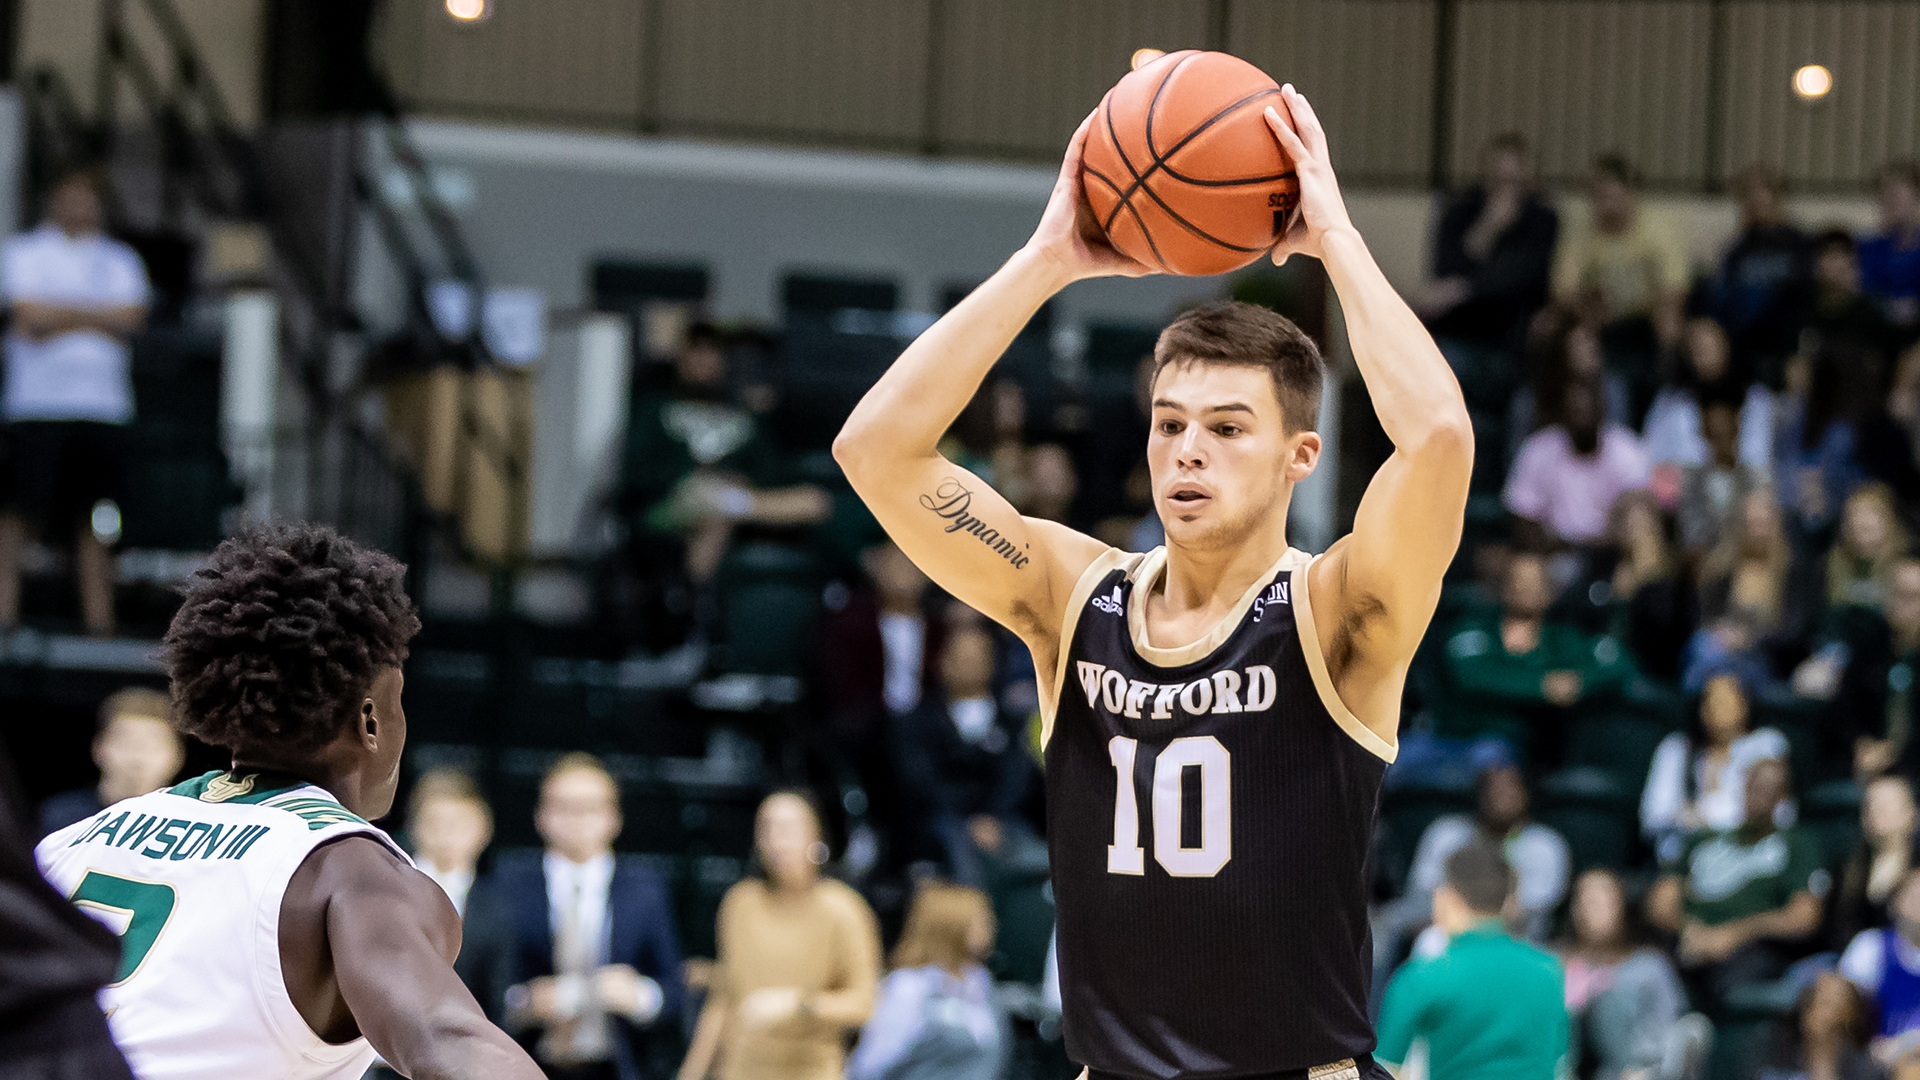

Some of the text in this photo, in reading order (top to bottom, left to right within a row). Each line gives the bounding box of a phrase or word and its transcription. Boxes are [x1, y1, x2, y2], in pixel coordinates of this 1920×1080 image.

[919, 476, 1029, 570] Dynamic
[1077, 660, 1277, 719] WOFFORD
[68, 811, 270, 861] DAWSON III
[1107, 735, 1232, 878] 10
